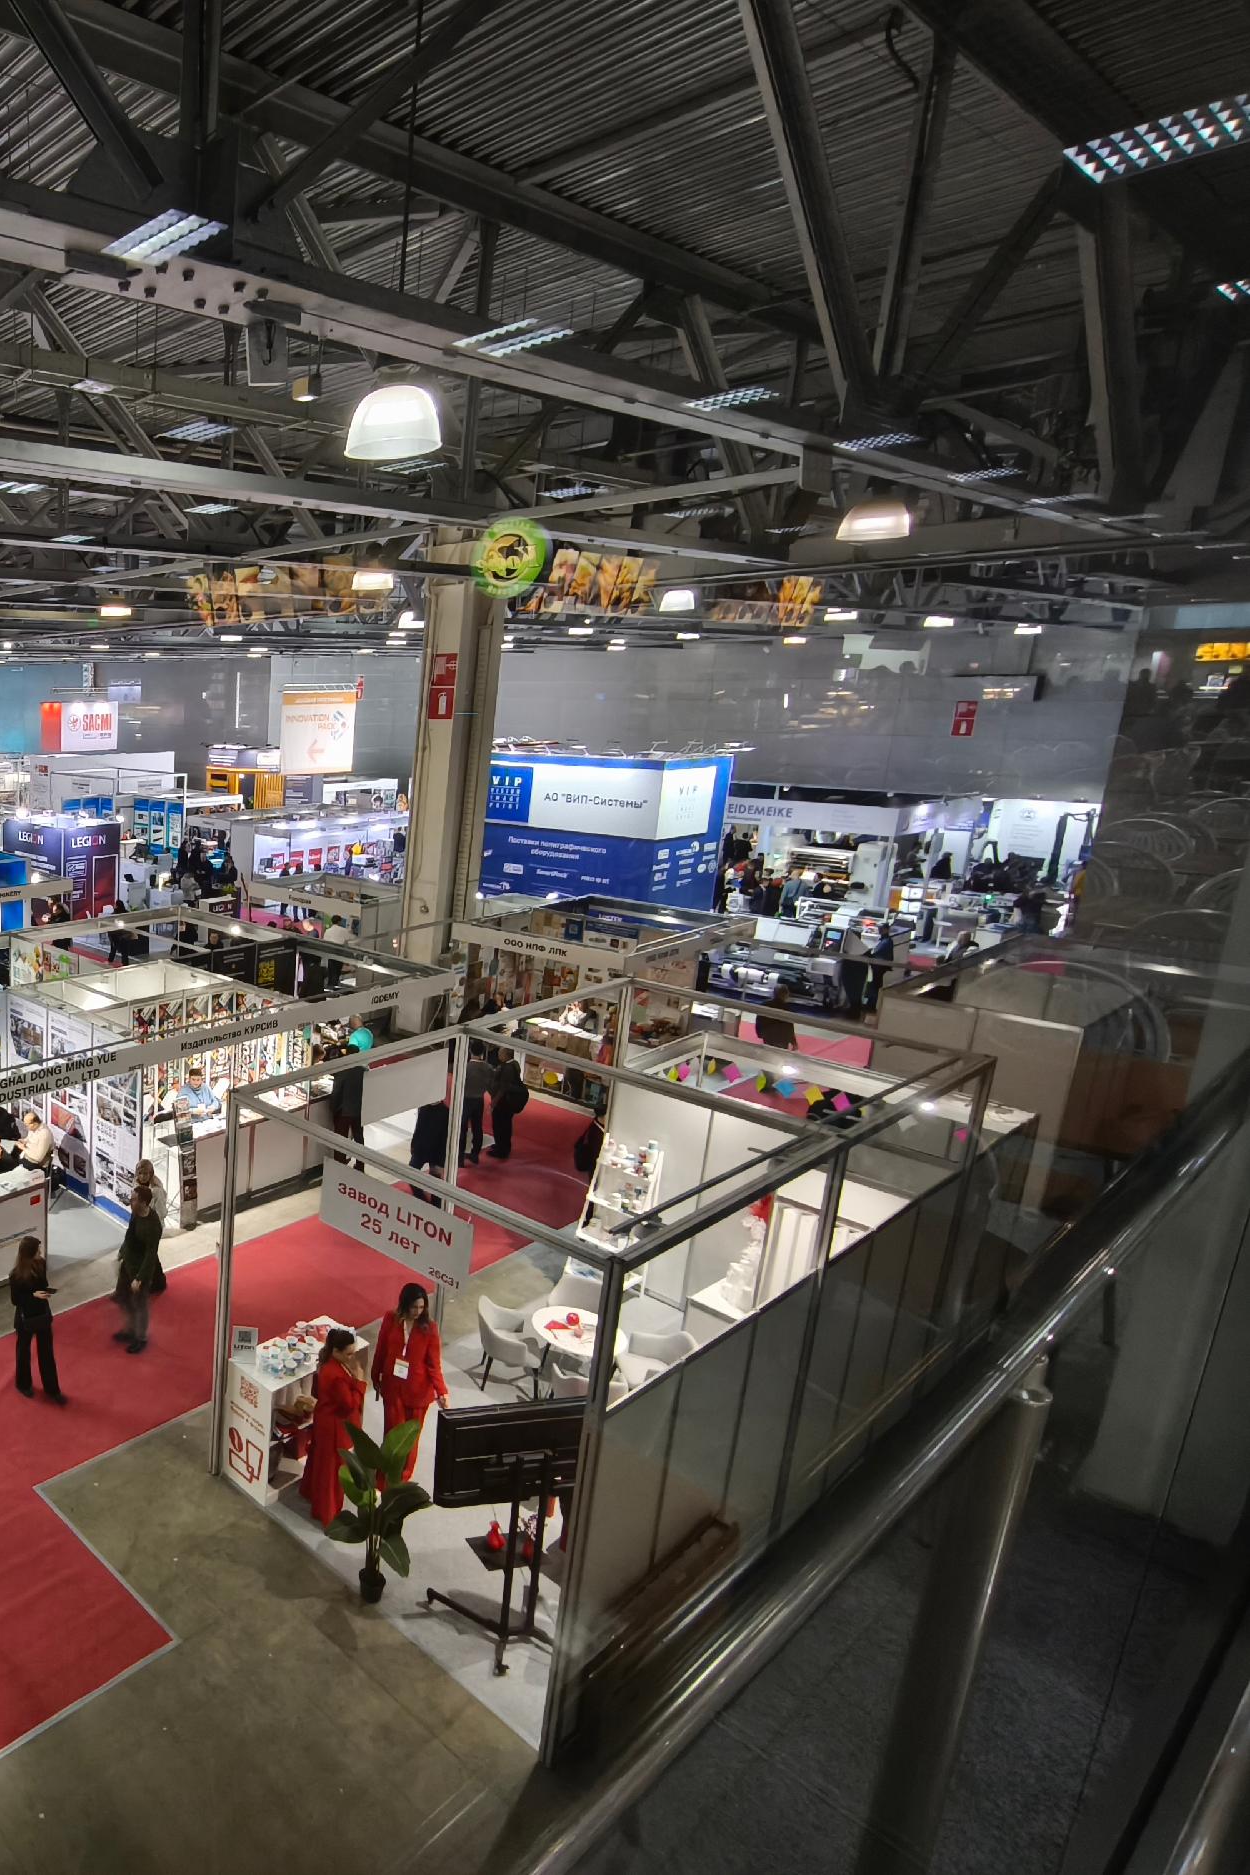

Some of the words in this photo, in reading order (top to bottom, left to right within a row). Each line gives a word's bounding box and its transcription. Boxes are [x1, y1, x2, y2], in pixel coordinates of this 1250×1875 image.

[82, 714, 112, 731] SACMI
[492, 775, 522, 787] VIP
[18, 831, 44, 845] LEGION
[71, 833, 106, 848] LEGION
[180, 1030, 242, 1051] Издательство
[244, 1019, 279, 1036] КУРСИВ
[30, 1064, 62, 1082] DONG
[65, 1057, 94, 1074] MING
[97, 1052, 117, 1065] YUE
[81, 1068, 101, 1083] LTD
[338, 1182, 390, 1219] завод
[396, 1206, 453, 1247] LITON
[360, 1213, 383, 1235] 25
[387, 1230, 421, 1255] лет
